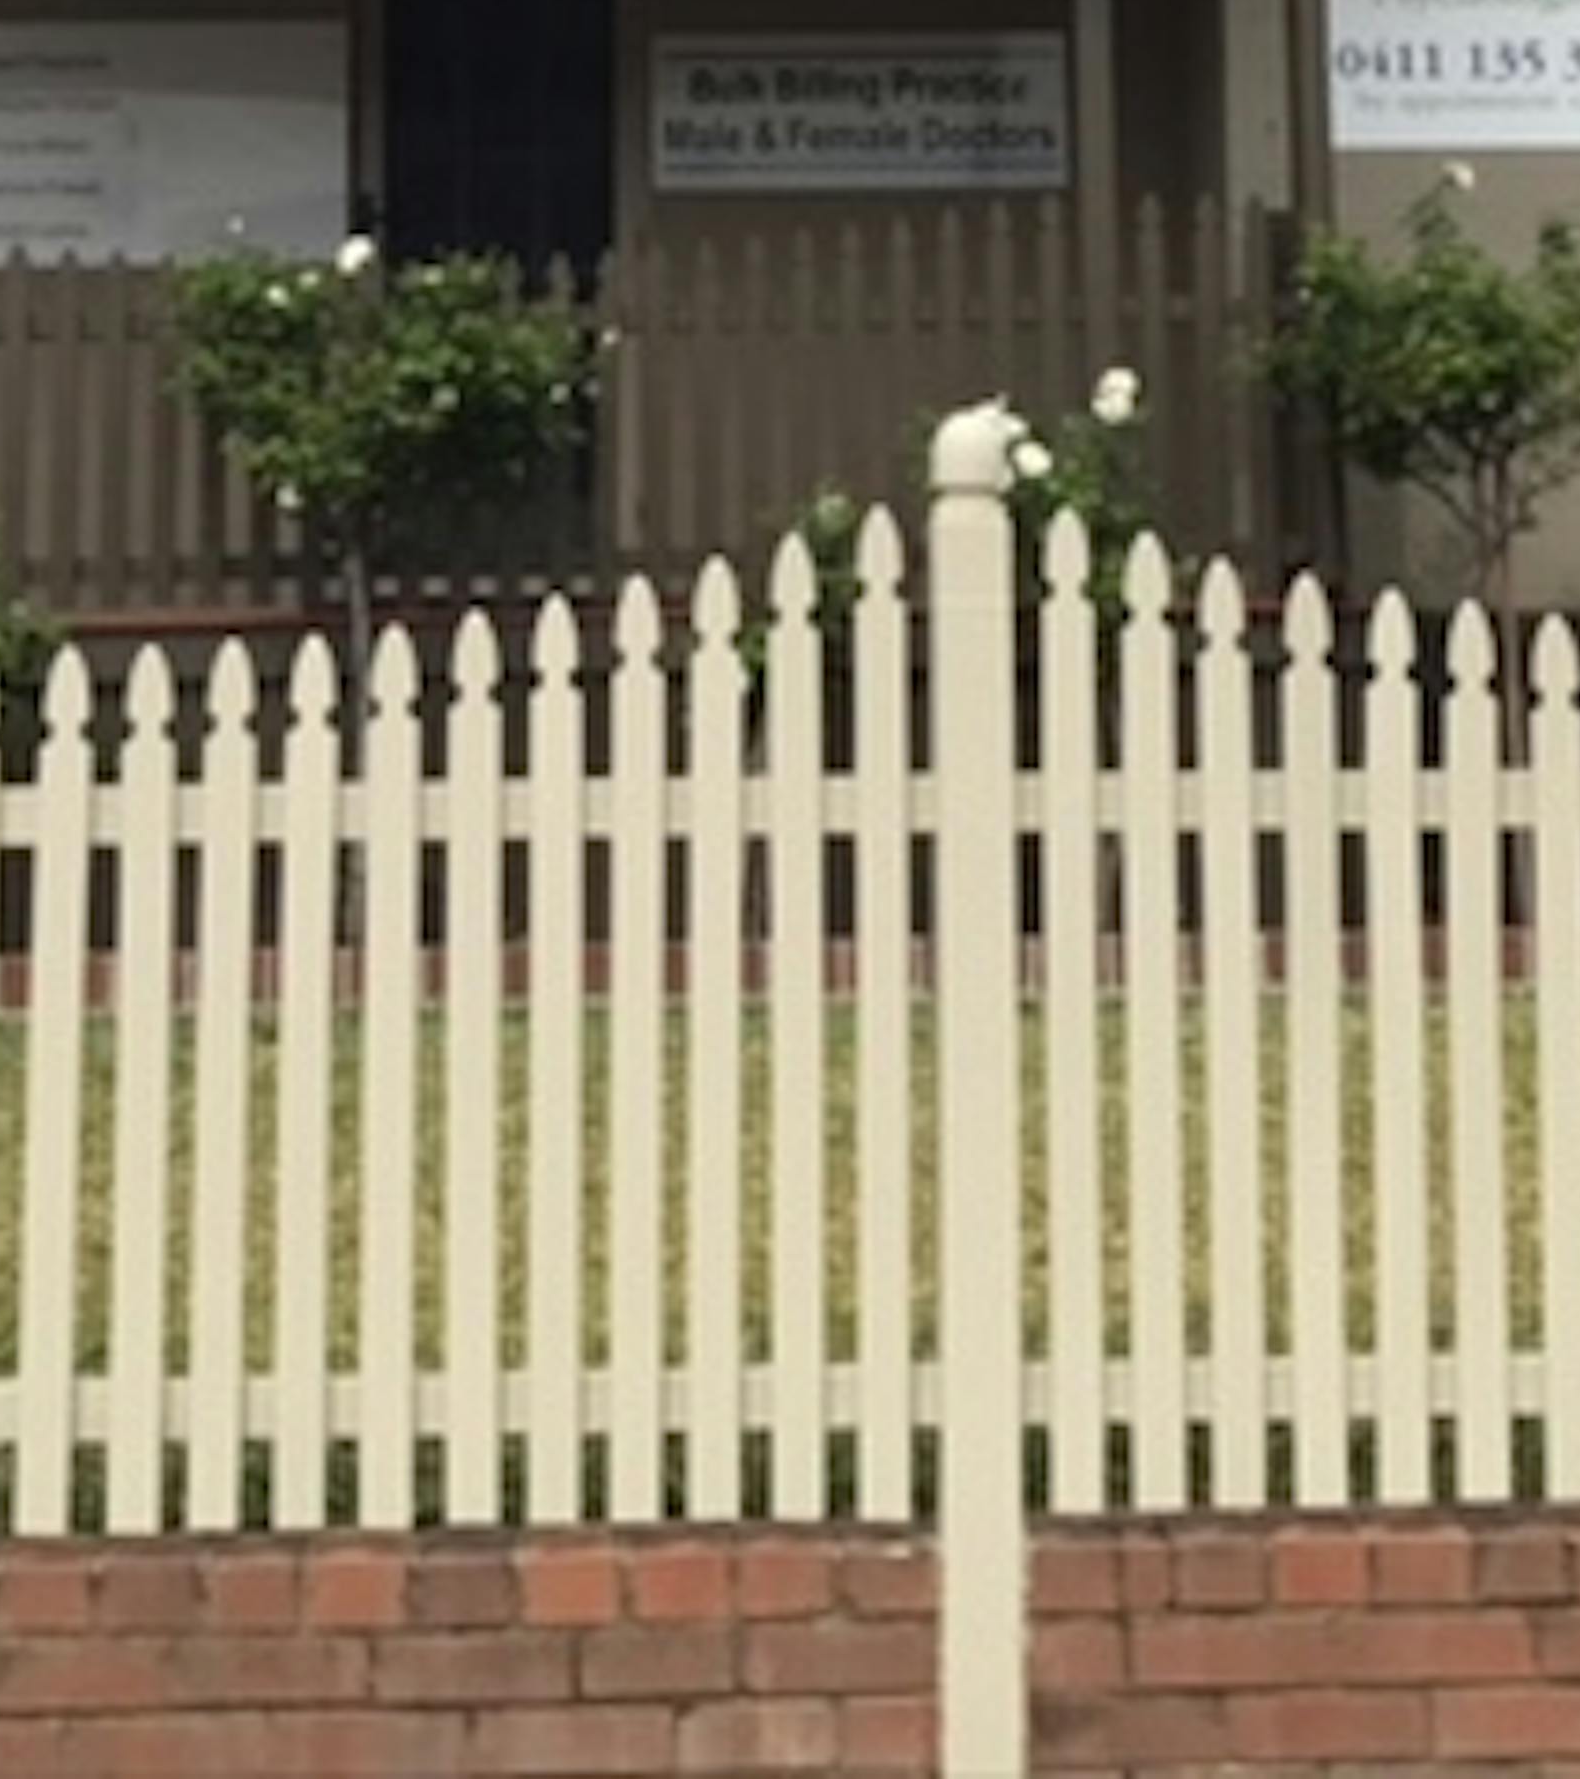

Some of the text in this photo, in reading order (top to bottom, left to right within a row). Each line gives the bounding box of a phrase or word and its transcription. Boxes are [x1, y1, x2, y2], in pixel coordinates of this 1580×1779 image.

[1335, 38, 1444, 82] 0411
[1468, 36, 1548, 83] 135
[774, 66, 881, 111] Billing
[892, 65, 1029, 105] Practice
[663, 117, 741, 152] Male
[788, 117, 910, 152] Female
[921, 116, 1058, 154] Doctors
